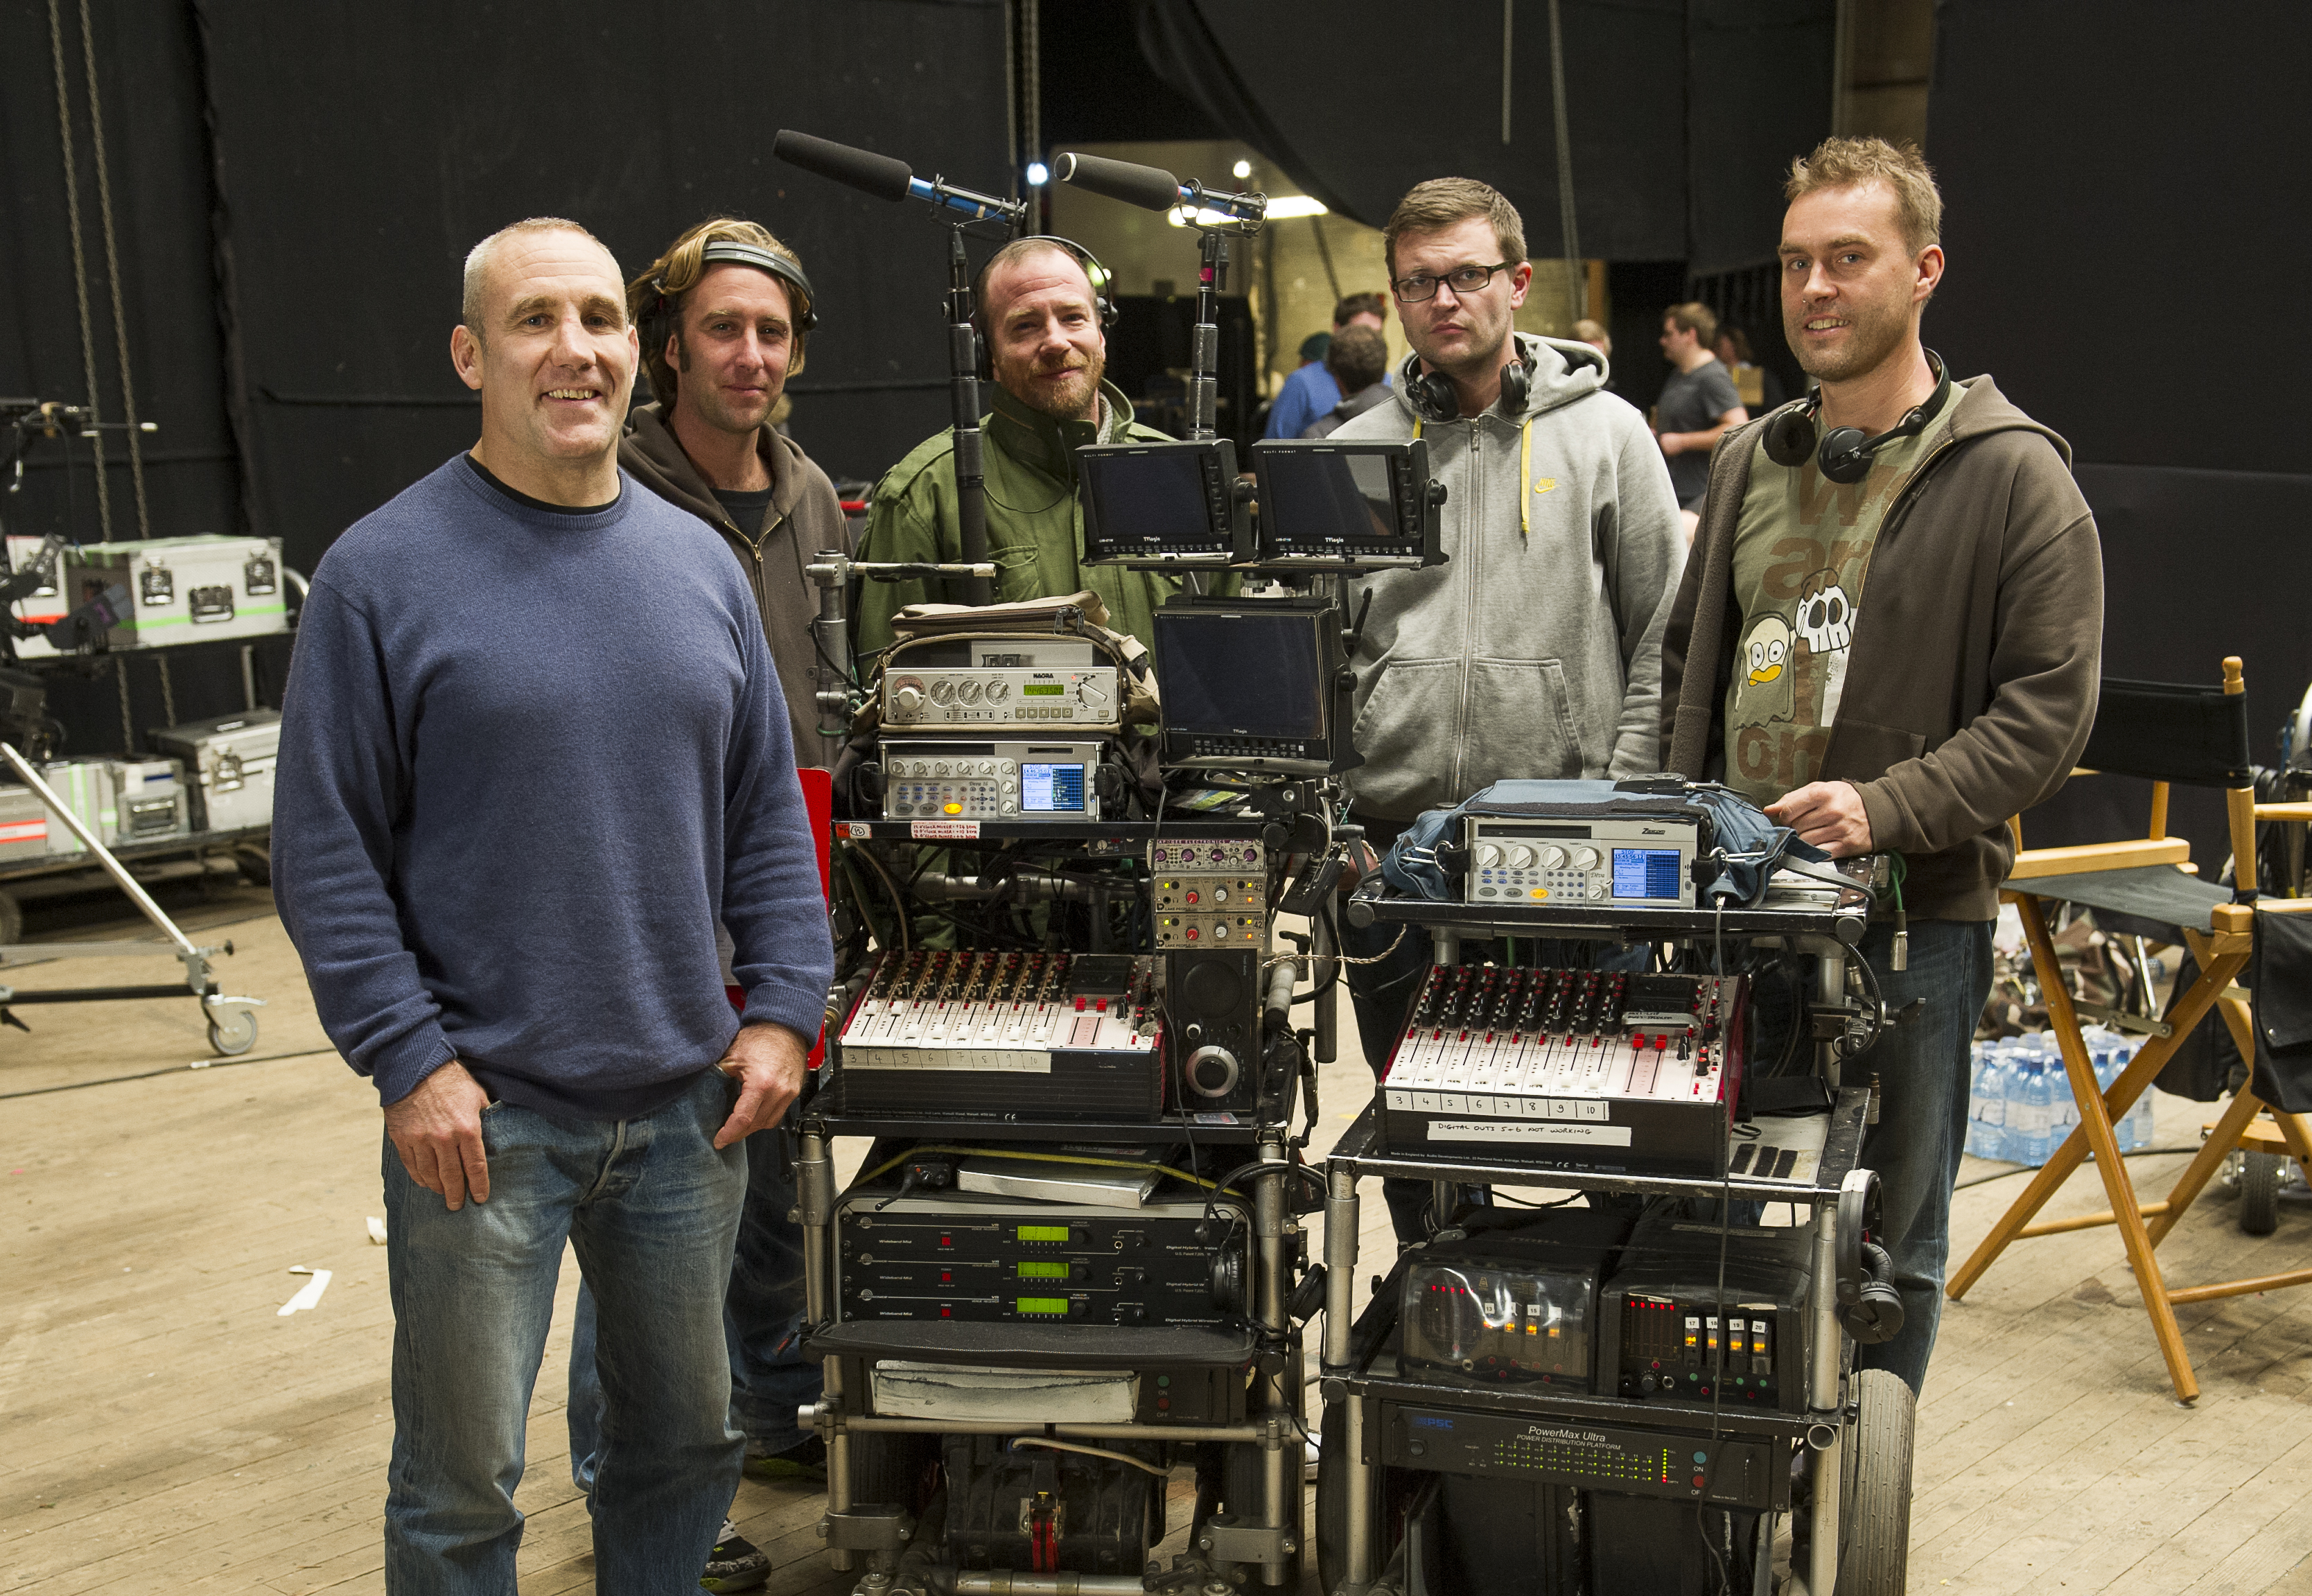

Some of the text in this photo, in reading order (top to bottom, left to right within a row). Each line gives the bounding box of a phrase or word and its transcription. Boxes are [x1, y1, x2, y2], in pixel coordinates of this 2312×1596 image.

[1539, 477, 1557, 488] NIKE
[875, 1054, 882, 1064] 4
[902, 1054, 909, 1063] 5
[929, 1054, 934, 1062] 6
[1006, 1054, 1012, 1067] 9
[1030, 1057, 1037, 1065] 10
[1476, 1100, 1482, 1108] 6
[1529, 1102, 1536, 1111] 8
[1557, 1105, 1564, 1113] 9
[1587, 1106, 1595, 1114] 10
[1529, 1426, 1605, 1442] PowerMax Ultra
[1541, 1436, 1585, 1446] DISTRIBUTION
[1587, 1442, 1621, 1450] PLATFORM
